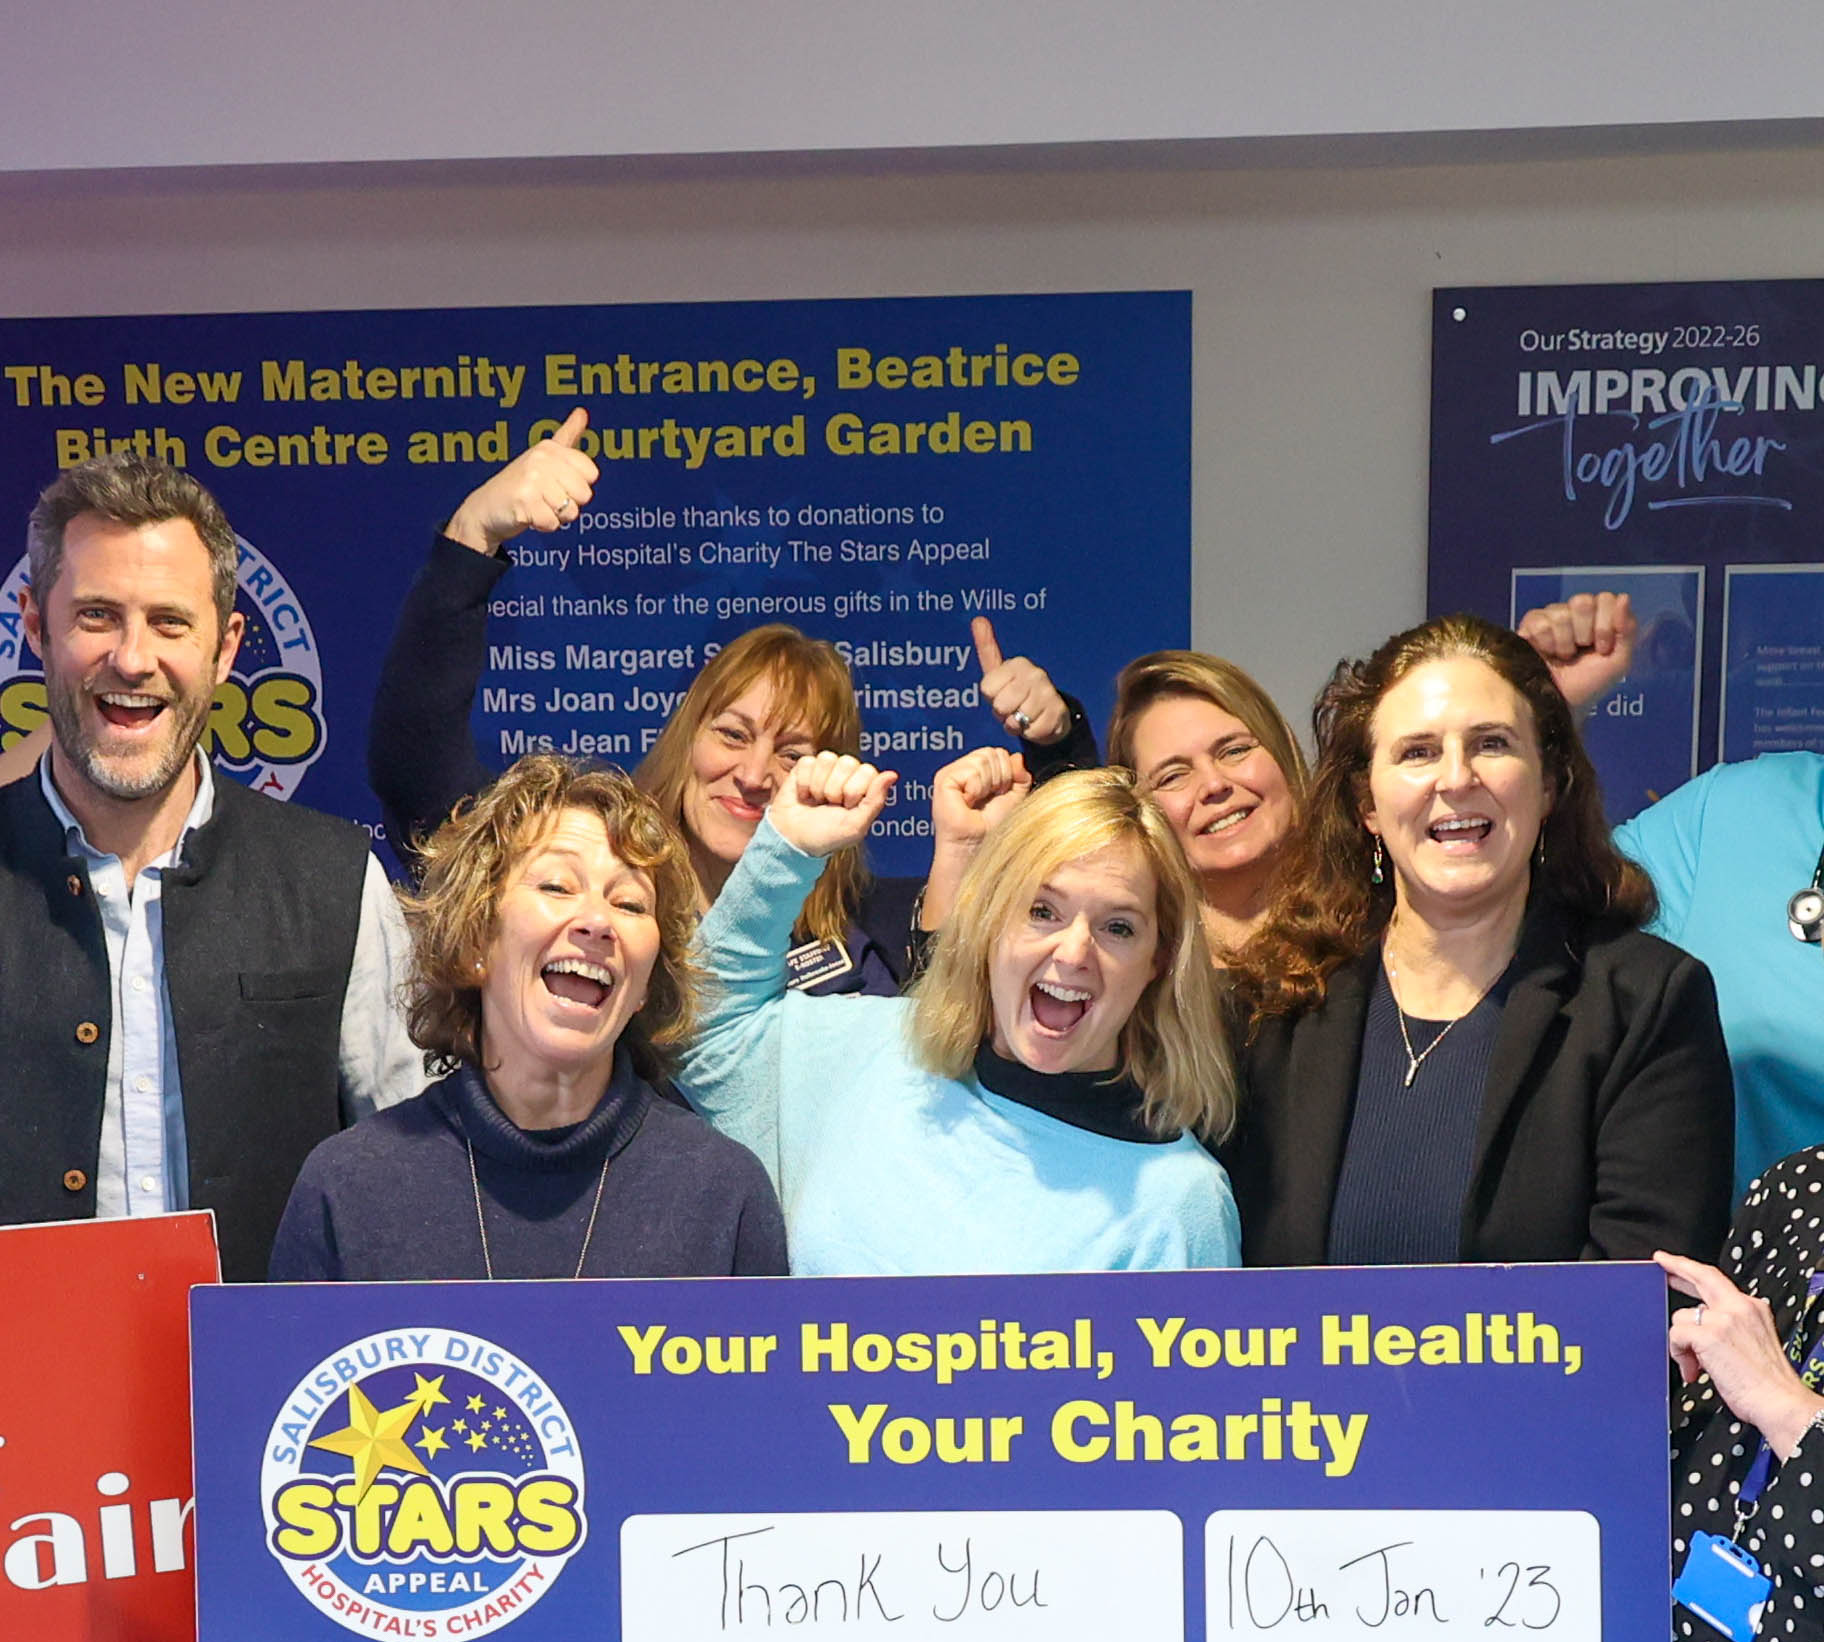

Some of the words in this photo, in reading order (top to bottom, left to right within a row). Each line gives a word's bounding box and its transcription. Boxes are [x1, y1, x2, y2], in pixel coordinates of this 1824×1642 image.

[1520, 329, 1565, 352] Our
[1567, 327, 1669, 354] Strategy
[1672, 325, 1761, 349] 2022-26
[4, 365, 106, 407] The
[124, 361, 242, 404] New
[261, 354, 526, 408] Maternity
[544, 353, 817, 400] Entrance,
[836, 343, 1080, 390] Beatrice
[55, 425, 187, 470] Birth
[204, 423, 389, 468] Centre
[407, 420, 510, 463] and
[824, 411, 1033, 455] Garden
[1490, 376, 1787, 530] Together
[579, 506, 676, 535] possible
[682, 504, 762, 530] thanks
[767, 506, 790, 528] to
[797, 502, 915, 528] donations
[920, 503, 945, 527] to
[506, 544, 571, 572] sbury
[577, 542, 691, 571] Hospital's
[698, 541, 782, 569] Charity
[787, 540, 833, 563] The
[839, 539, 900, 563] Stars
[906, 537, 990, 565] Appeal
[551, 594, 629, 617] thanks
[634, 593, 666, 615] for
[671, 593, 709, 615] the
[715, 595, 828, 620] generous
[833, 590, 882, 619] gifts
[889, 590, 910, 612] in
[917, 590, 954, 612] the
[959, 588, 1016, 611] Wills
[1023, 587, 1047, 610] of
[488, 645, 556, 671] Miss
[565, 644, 695, 676] Margaret
[482, 687, 537, 713] Mrs
[544, 686, 615, 713] Joan
[1606, 692, 1645, 717] did
[499, 729, 554, 755] Mrs
[562, 728, 631, 754] Jean
[859, 725, 964, 758] eparish
[617, 1324, 776, 1375] Your
[800, 1318, 1115, 1385] Hospital,
[1136, 1316, 1297, 1370] Your
[1320, 1312, 1583, 1375] Health,
[272, 1334, 432, 1466] SALISBURY
[444, 1337, 576, 1460] DISTRICT
[827, 1403, 1024, 1464] Your
[1050, 1396, 1369, 1478] Charity
[276, 1480, 578, 1558] STARS
[300, 1564, 438, 1639] HOSPITAL'S
[446, 1562, 547, 1636] CHARITY
[363, 1572, 490, 1594] APPEAL
[672, 1525, 906, 1631] Thank
[934, 1536, 1049, 1623] You
[1228, 1534, 1331, 1631] 10th
[1338, 1541, 1449, 1628] Jan
[1478, 1562, 1563, 1631] '23
